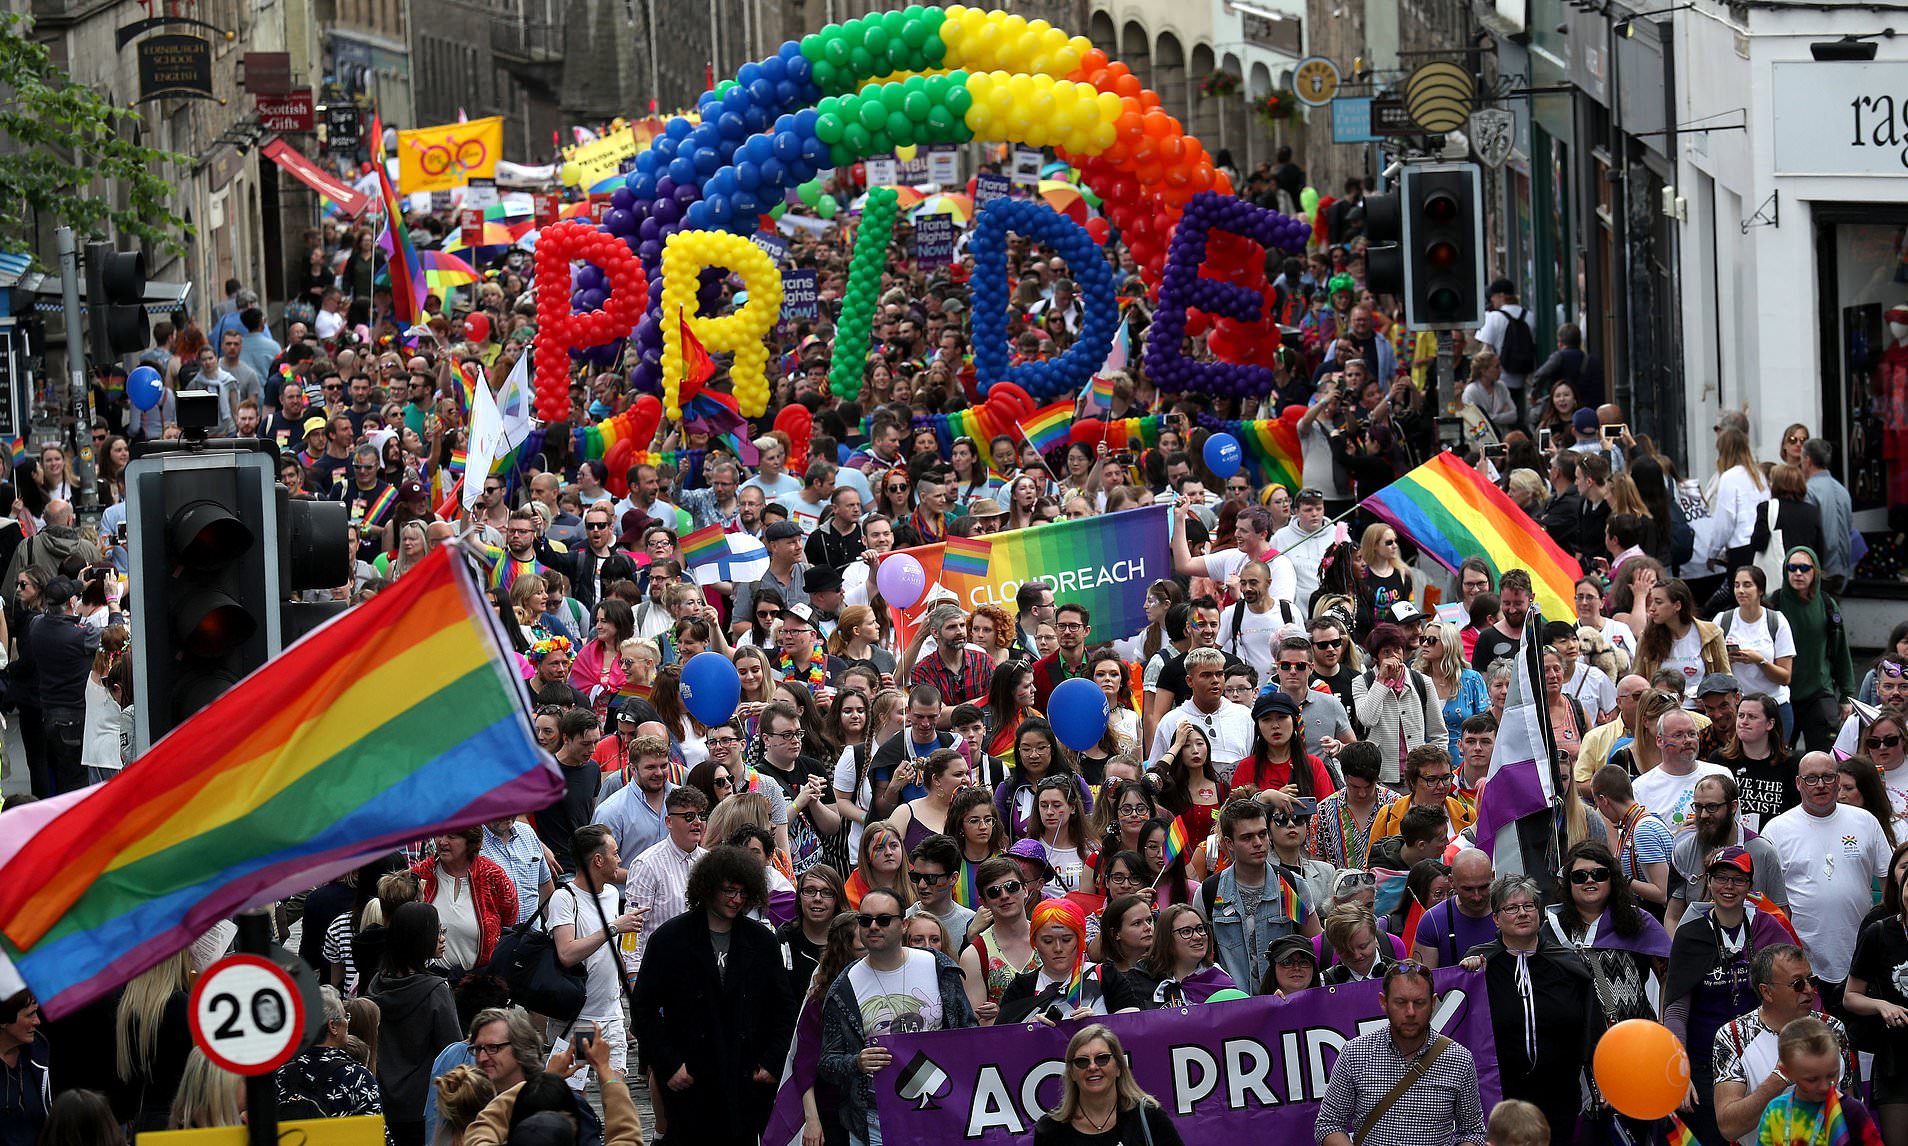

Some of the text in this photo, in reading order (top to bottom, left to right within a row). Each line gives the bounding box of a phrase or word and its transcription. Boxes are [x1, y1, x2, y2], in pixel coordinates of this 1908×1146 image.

[144, 44, 204, 55] EDINBURGH
[153, 56, 194, 65] SCHOOL
[155, 72, 197, 82] ENGLISH
[258, 103, 308, 116] Scottish
[271, 117, 300, 130] Gifts
[977, 178, 1009, 192] Trans
[917, 219, 950, 231] Trans
[917, 231, 951, 245] Rights
[917, 243, 952, 258] Now!
[781, 277, 814, 290] rans
[783, 290, 816, 307] ights
[970, 557, 1145, 607] CLODREACH
[1376, 586, 1401, 608] Love
[1735, 777, 1783, 793] VE THE
[208, 987, 287, 1041] 20
[1168, 1016, 1390, 1118] PRID
